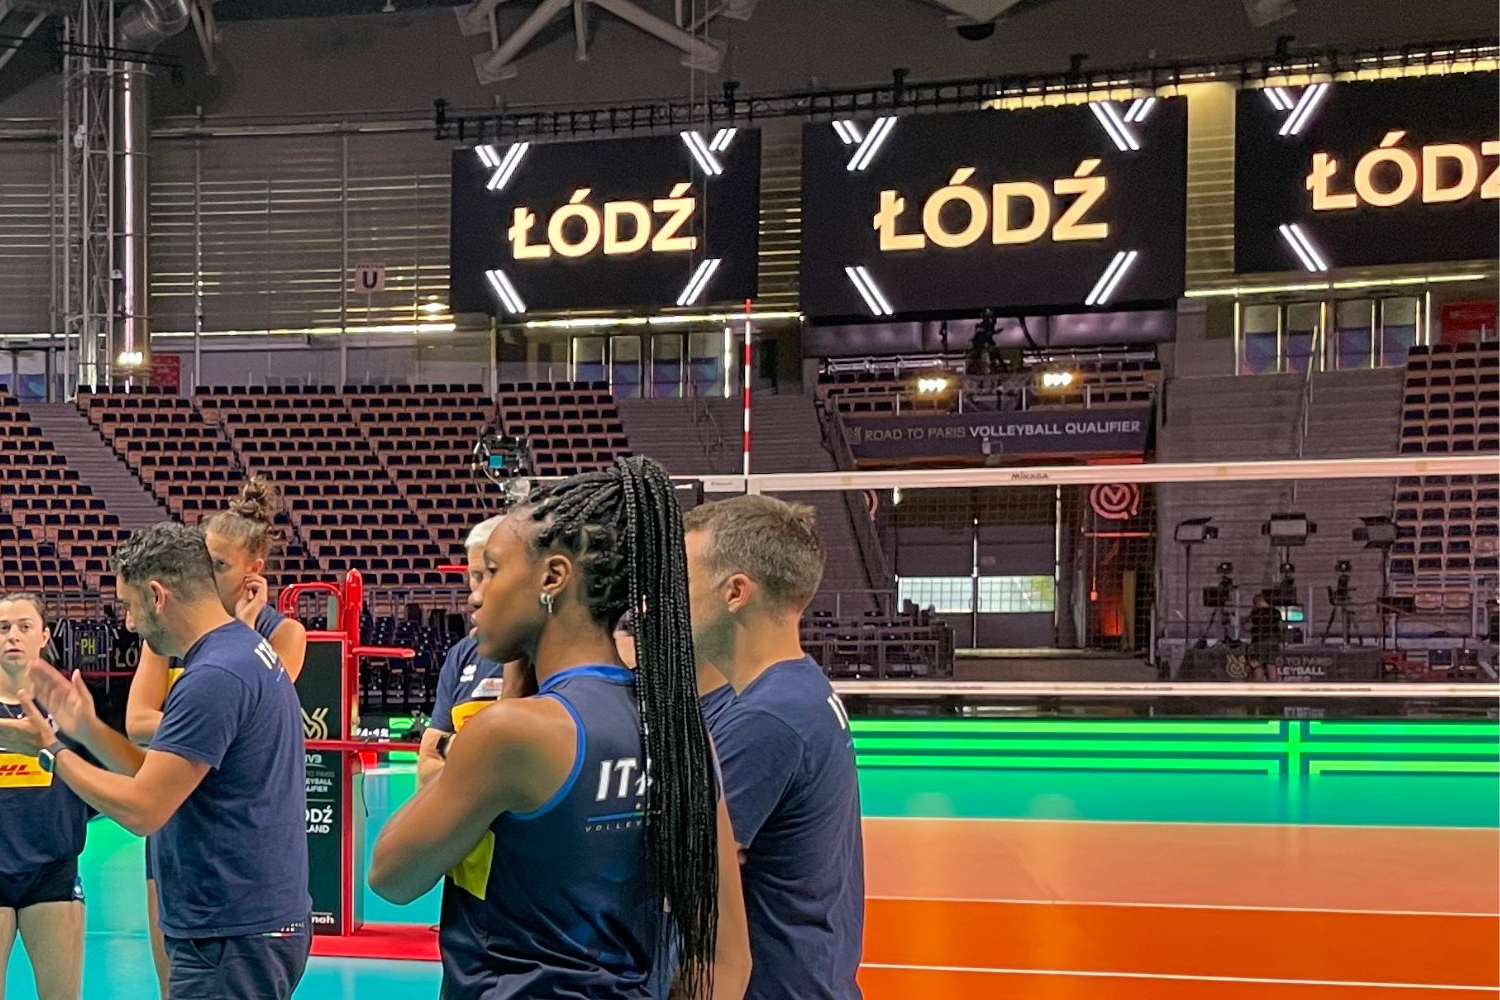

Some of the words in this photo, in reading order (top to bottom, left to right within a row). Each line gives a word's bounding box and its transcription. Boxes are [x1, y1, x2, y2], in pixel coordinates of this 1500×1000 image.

[873, 159, 1108, 251] ŁÓDŹ
[508, 182, 698, 260] ŁÓDŹ
[362, 271, 378, 289] U
[865, 430, 902, 442] ROAD
[907, 428, 924, 440] TO
[928, 426, 966, 439] PARIS
[969, 424, 1061, 438] VOLLEYBALL
[1065, 420, 1141, 435] QUALIFIER
[80, 638, 96, 655] PH
